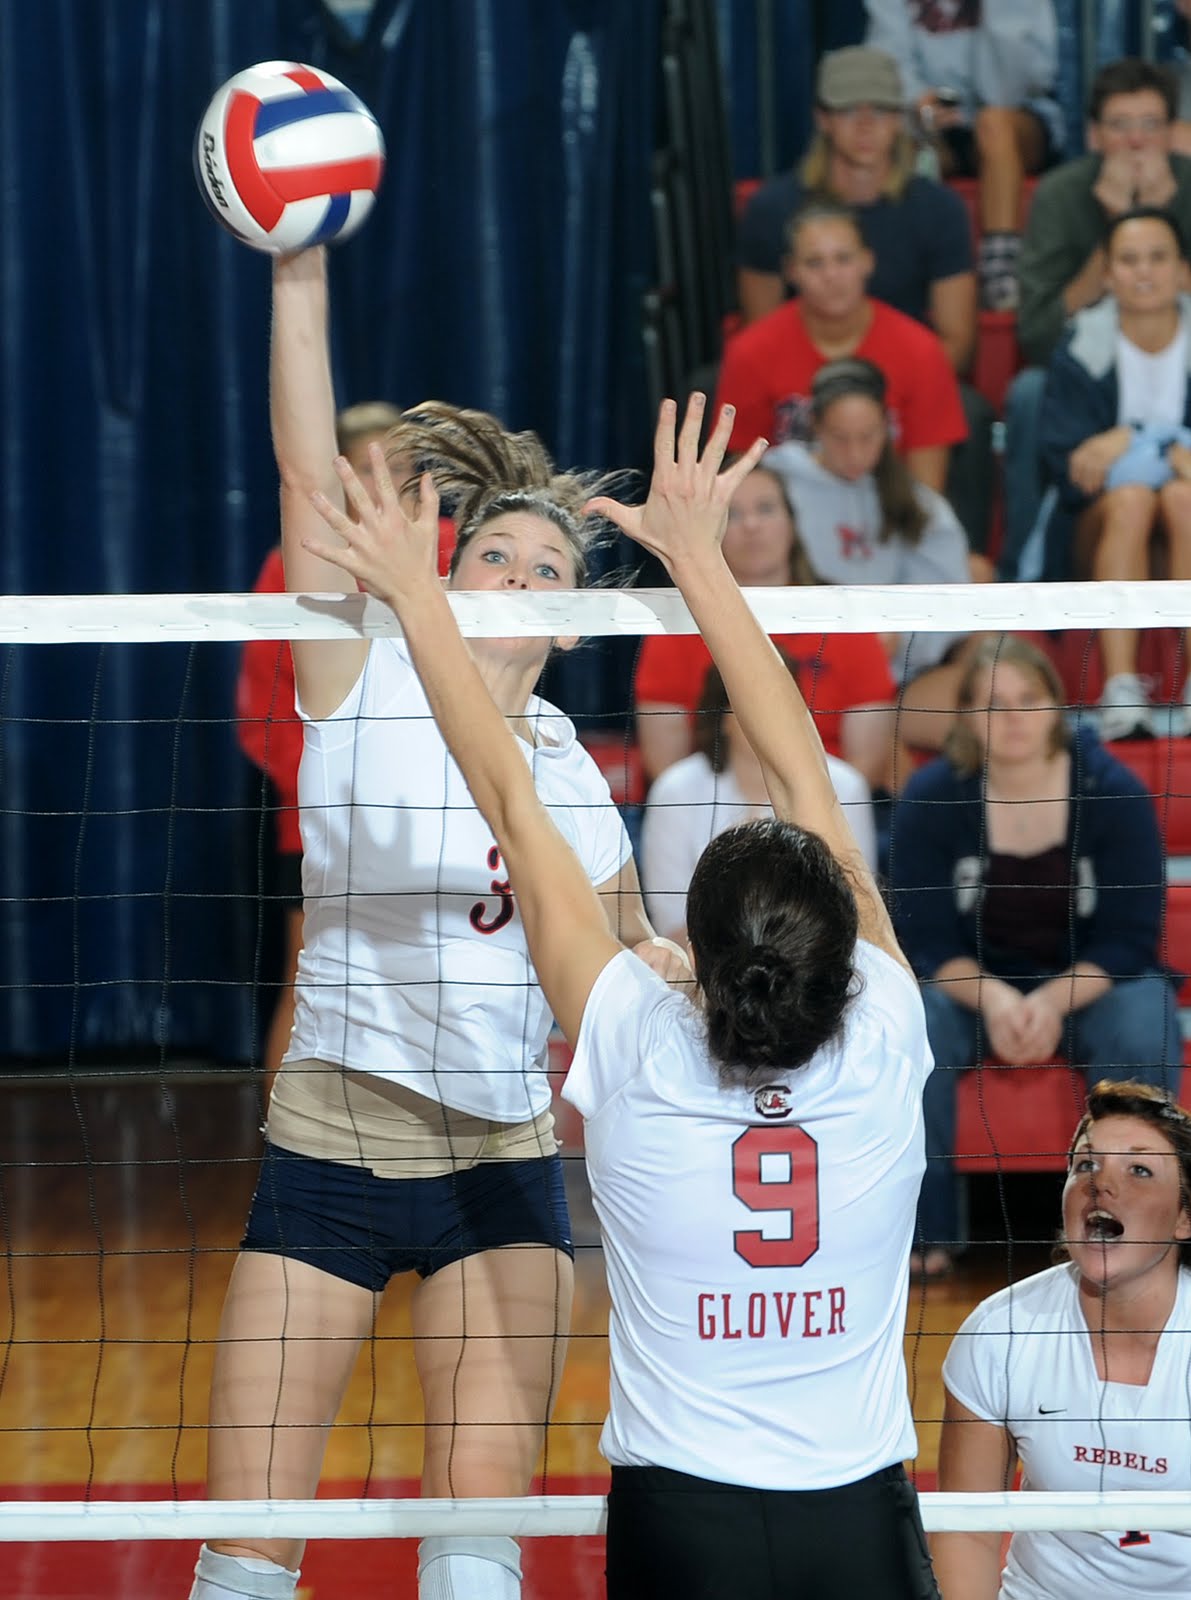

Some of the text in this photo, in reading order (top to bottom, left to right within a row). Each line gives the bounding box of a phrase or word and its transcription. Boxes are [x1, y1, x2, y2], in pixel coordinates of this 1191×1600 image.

[732, 1124, 820, 1268] 9
[698, 1286, 845, 1340] GLOVER
[1073, 1445, 1168, 1474] REBELS
